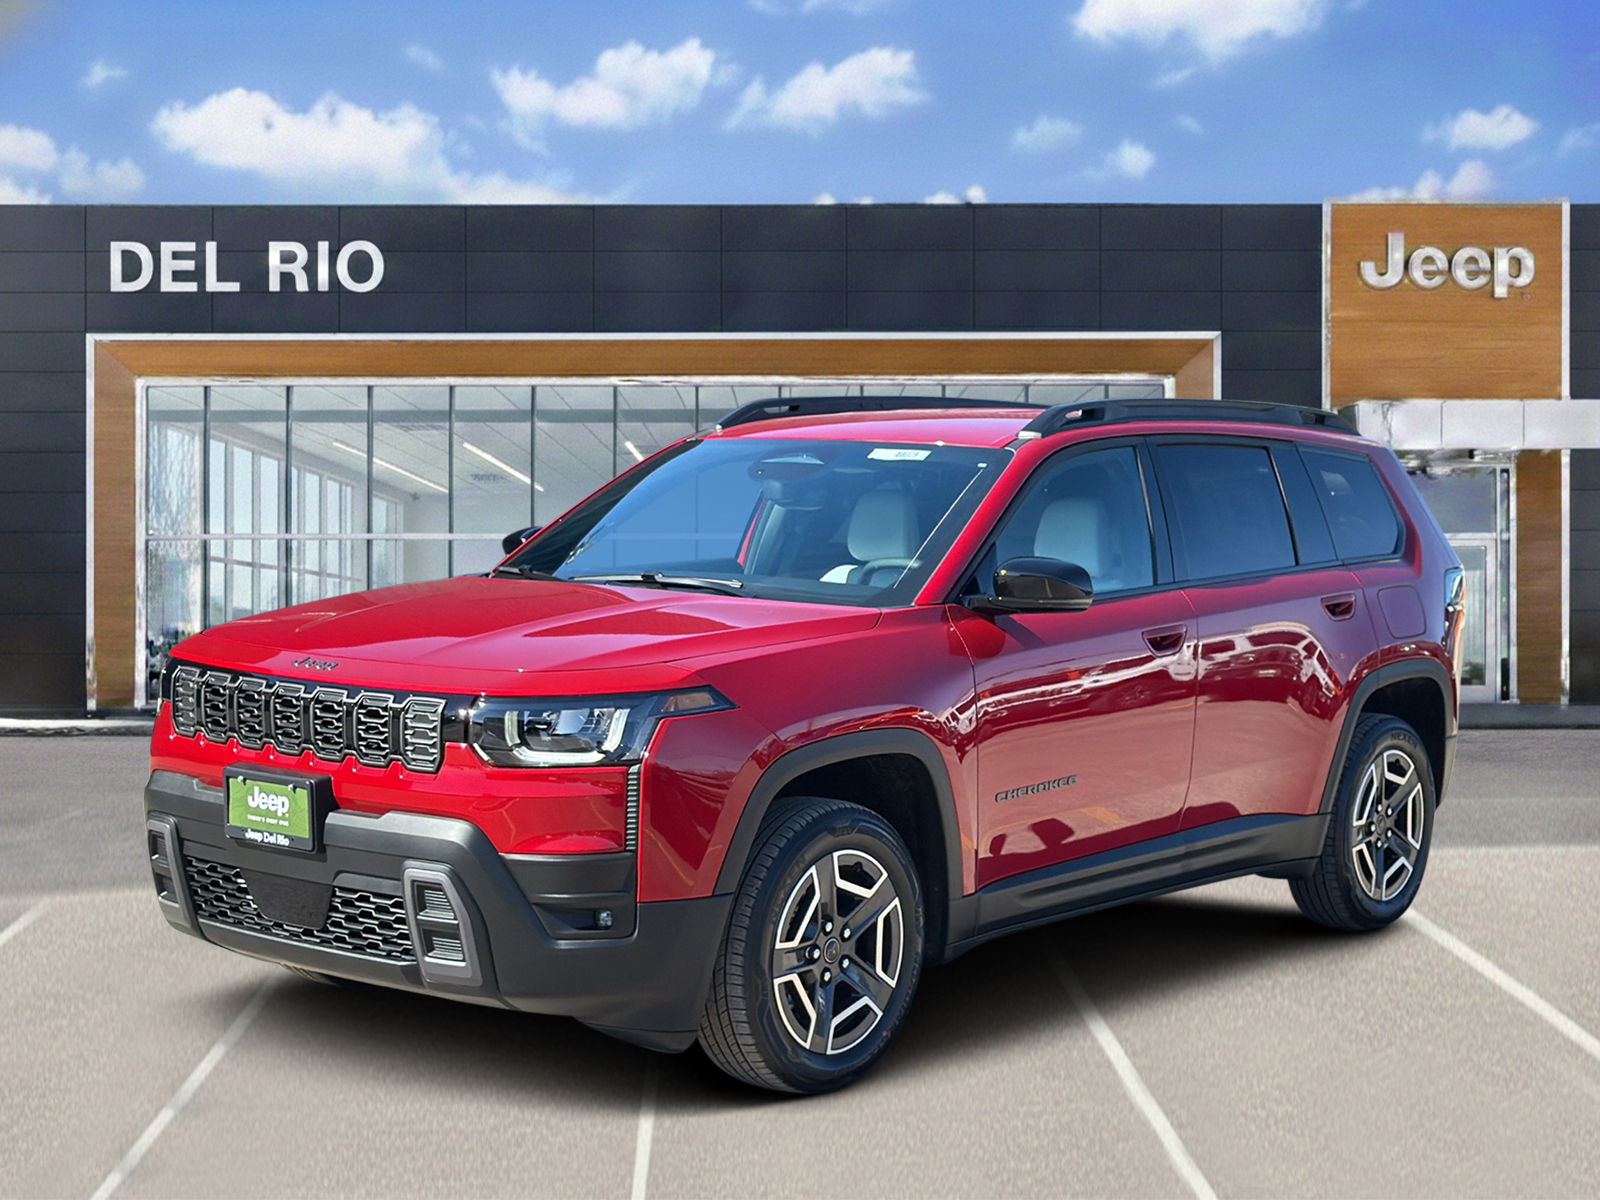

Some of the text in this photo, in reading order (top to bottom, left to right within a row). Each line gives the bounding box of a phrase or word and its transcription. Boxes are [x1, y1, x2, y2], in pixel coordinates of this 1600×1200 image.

[110, 240, 385, 293] DEL RIO
[1360, 232, 1535, 298] Jeep
[291, 656, 338, 671] Jeep
[247, 785, 290, 817] Jeep
[995, 774, 1077, 802] CHEROKEE
[245, 828, 290, 846] Jeep Del Rio
